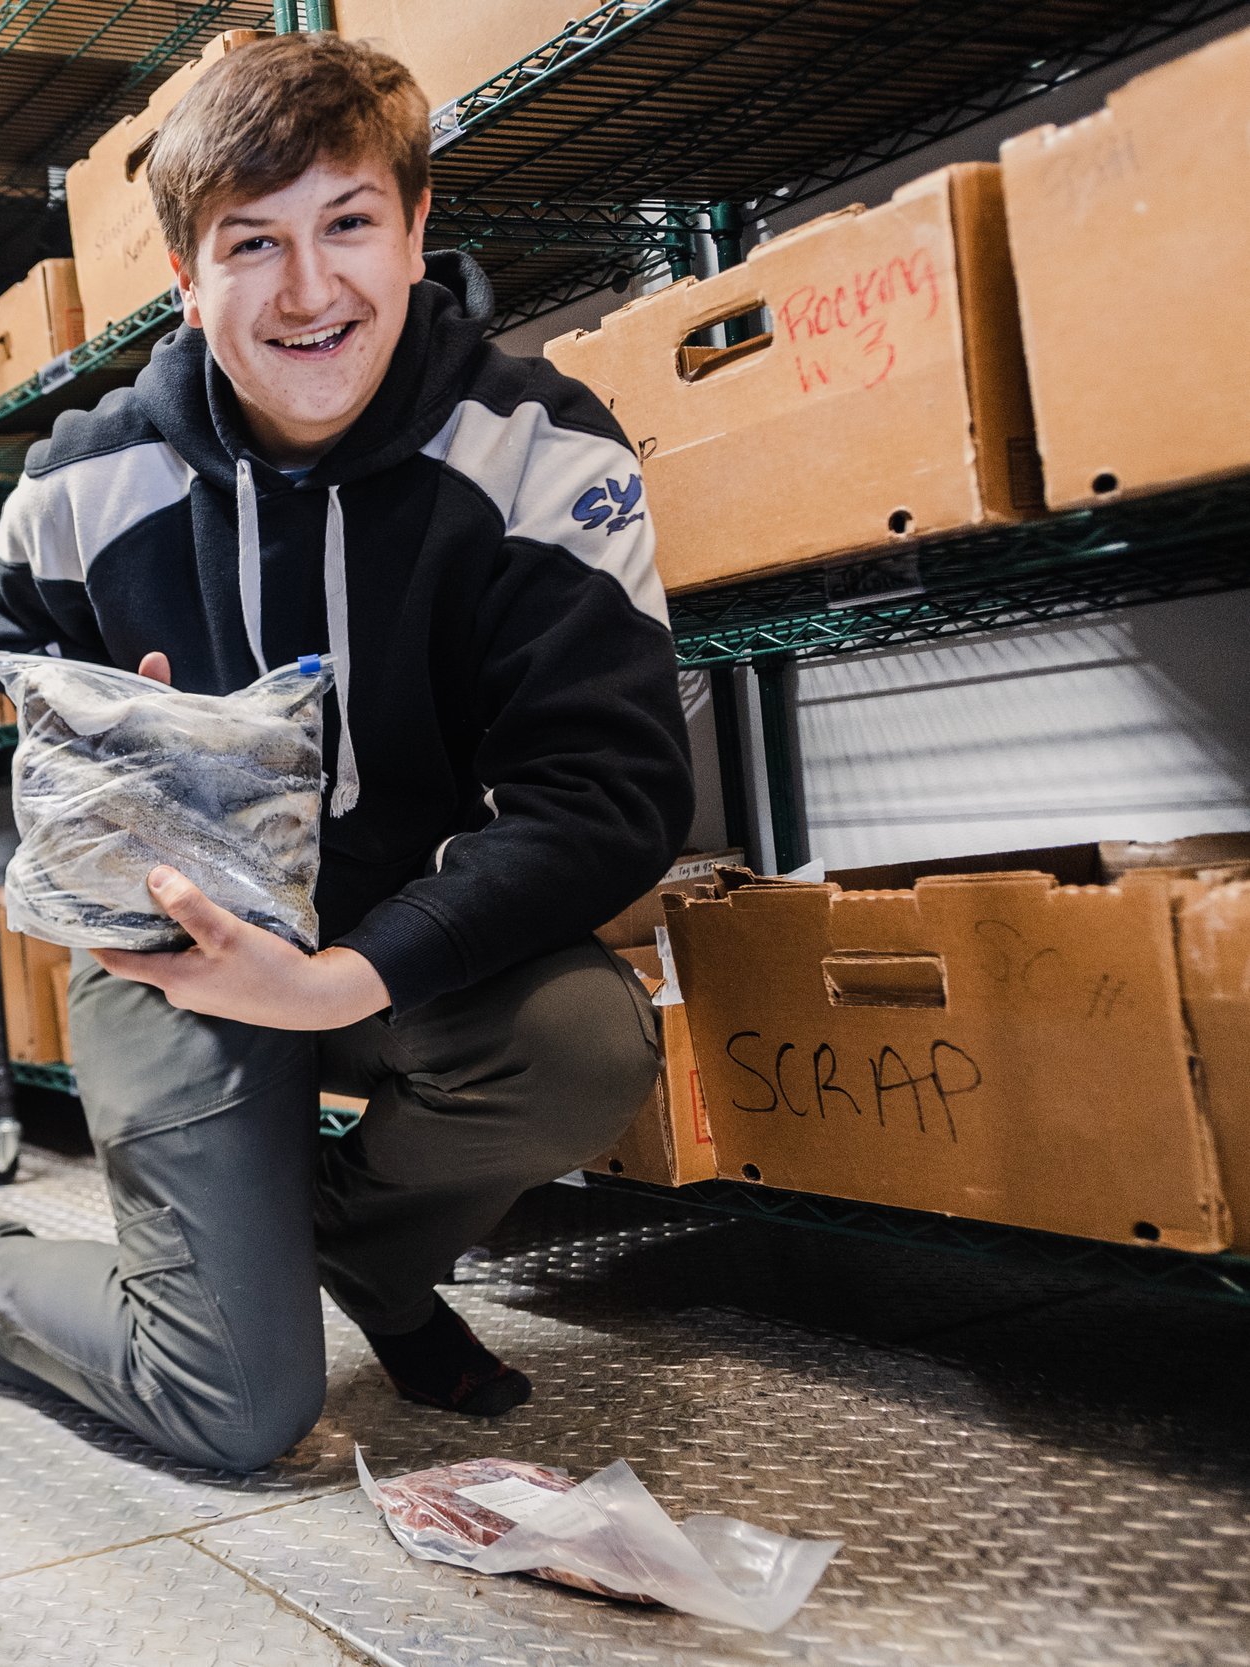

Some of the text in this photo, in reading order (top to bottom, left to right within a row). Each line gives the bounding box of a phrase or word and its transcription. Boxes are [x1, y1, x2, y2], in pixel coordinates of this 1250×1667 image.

[778, 247, 940, 344] Rocking
[855, 318, 896, 390] 3
[571, 473, 643, 531] SY
[725, 1030, 982, 1144] SCRAP
